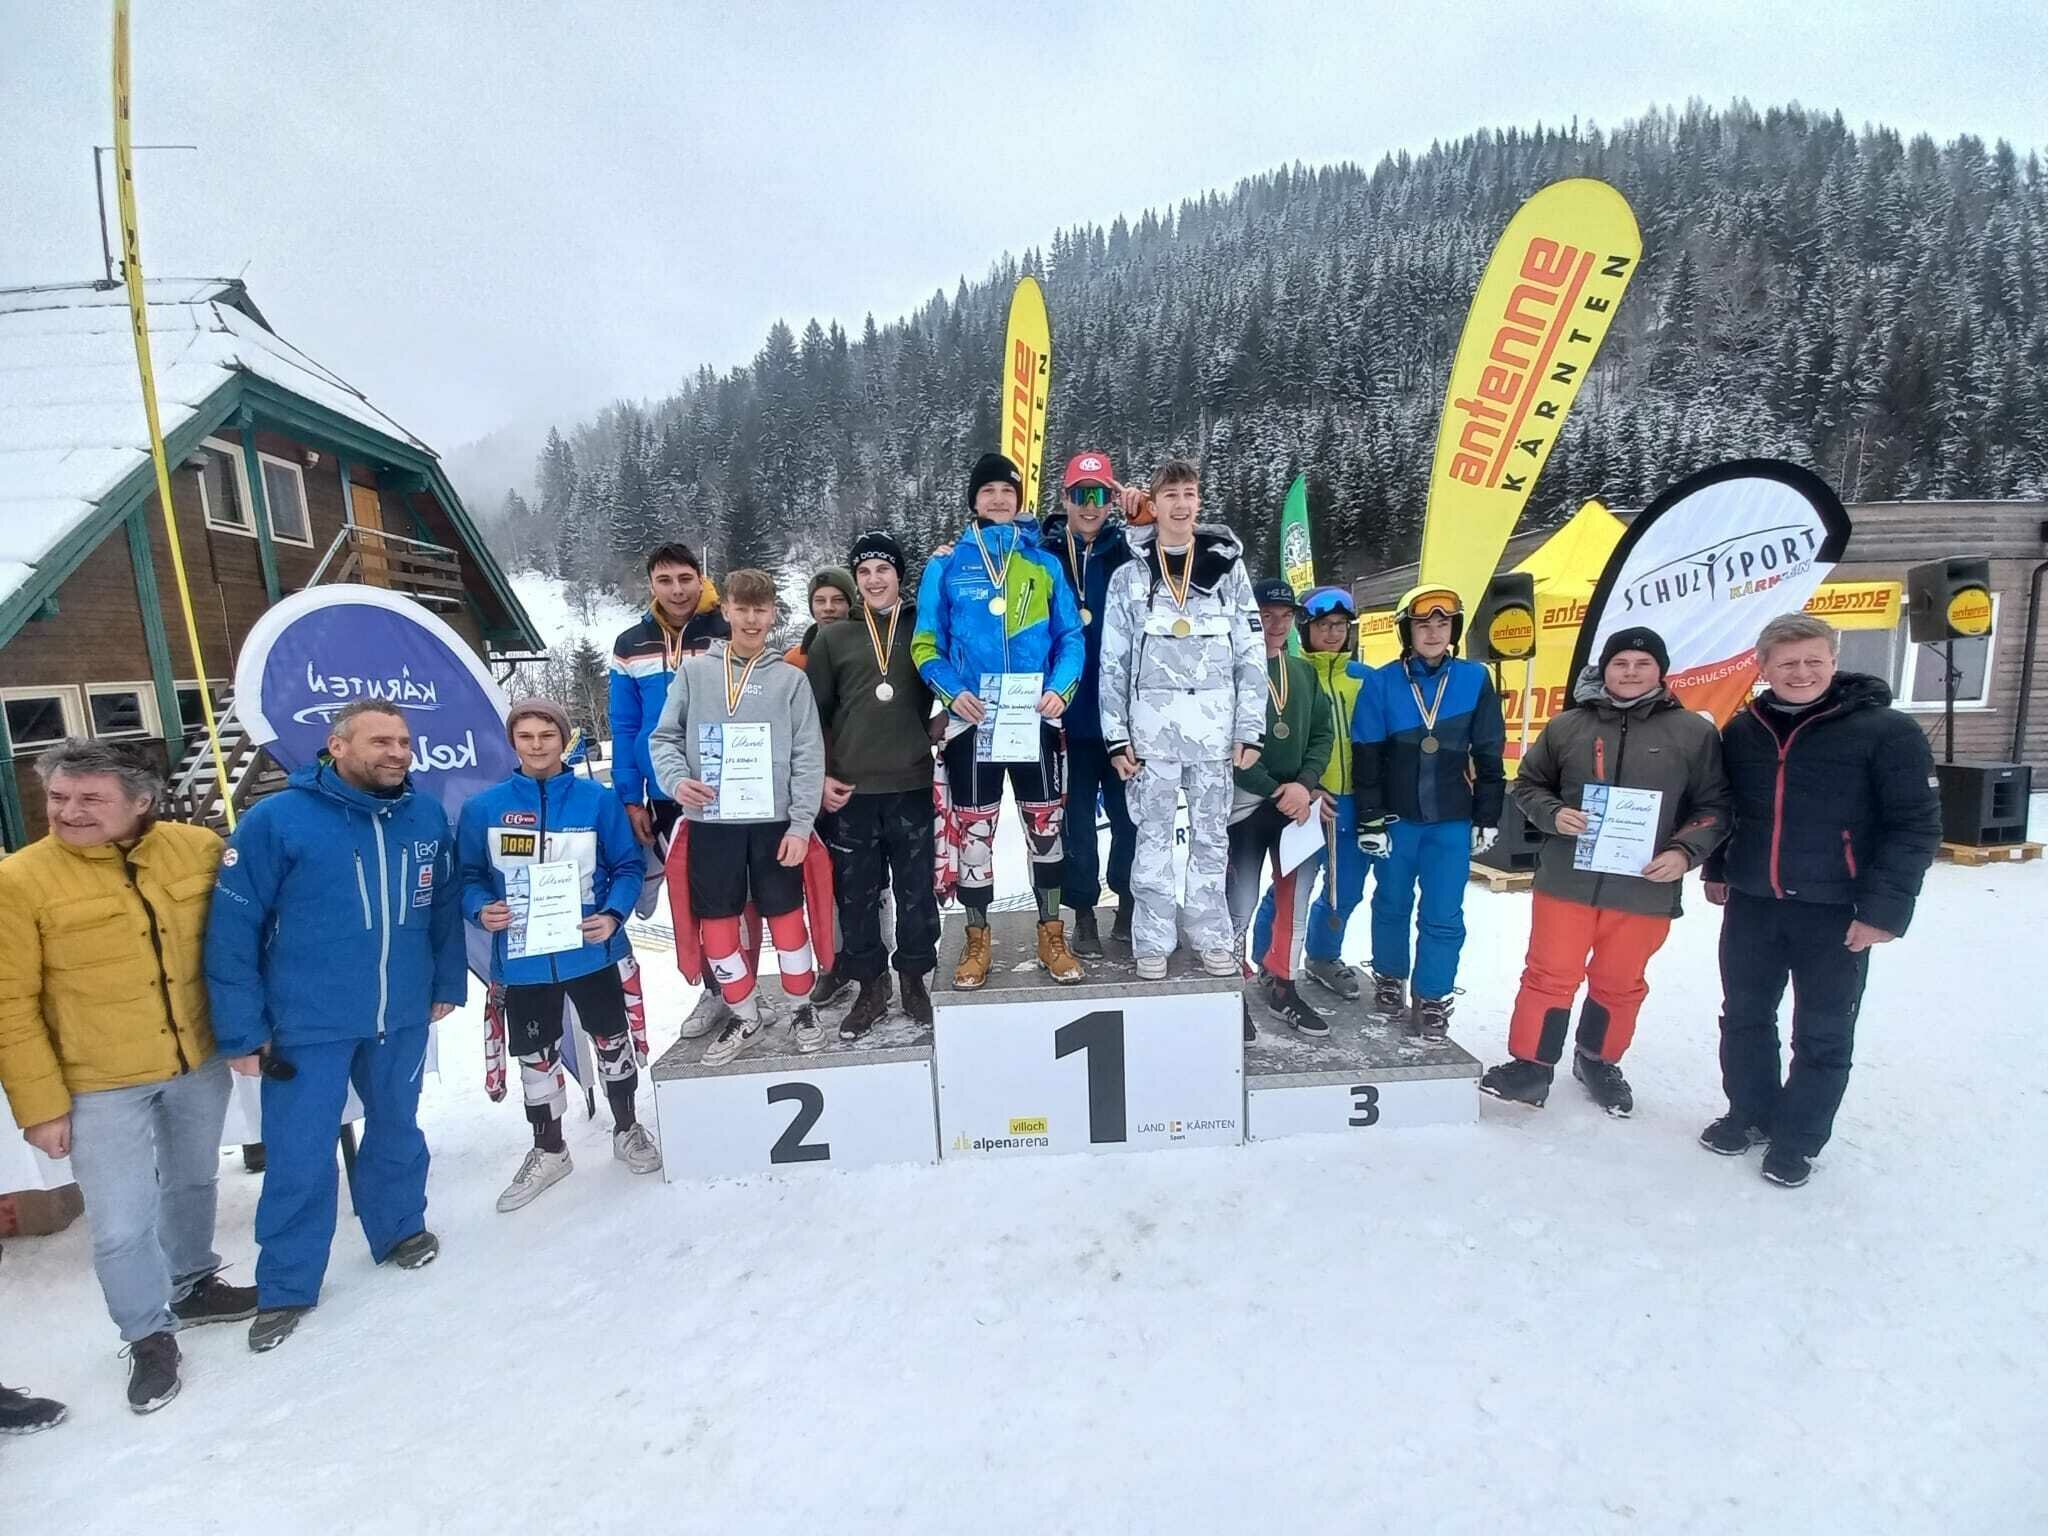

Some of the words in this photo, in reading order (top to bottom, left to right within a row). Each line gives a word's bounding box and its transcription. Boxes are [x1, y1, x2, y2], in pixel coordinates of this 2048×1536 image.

[1449, 237, 1578, 486] antenne
[1501, 255, 1631, 492] KÄRNTEN
[1543, 599, 1588, 624] ante
[1803, 588, 1890, 612] antenne
[1952, 604, 1988, 618] antenne
[1493, 624, 1531, 639] antenne
[1055, 1010, 1127, 1144] 1
[1348, 1086, 1380, 1128] 3
[767, 1082, 830, 1164] 2
[1012, 1121, 1045, 1132] villach
[1137, 1122, 1166, 1133] LAND
[1186, 1119, 1235, 1131] KÄRNTEN
[973, 1135, 1049, 1151] alpenarena
